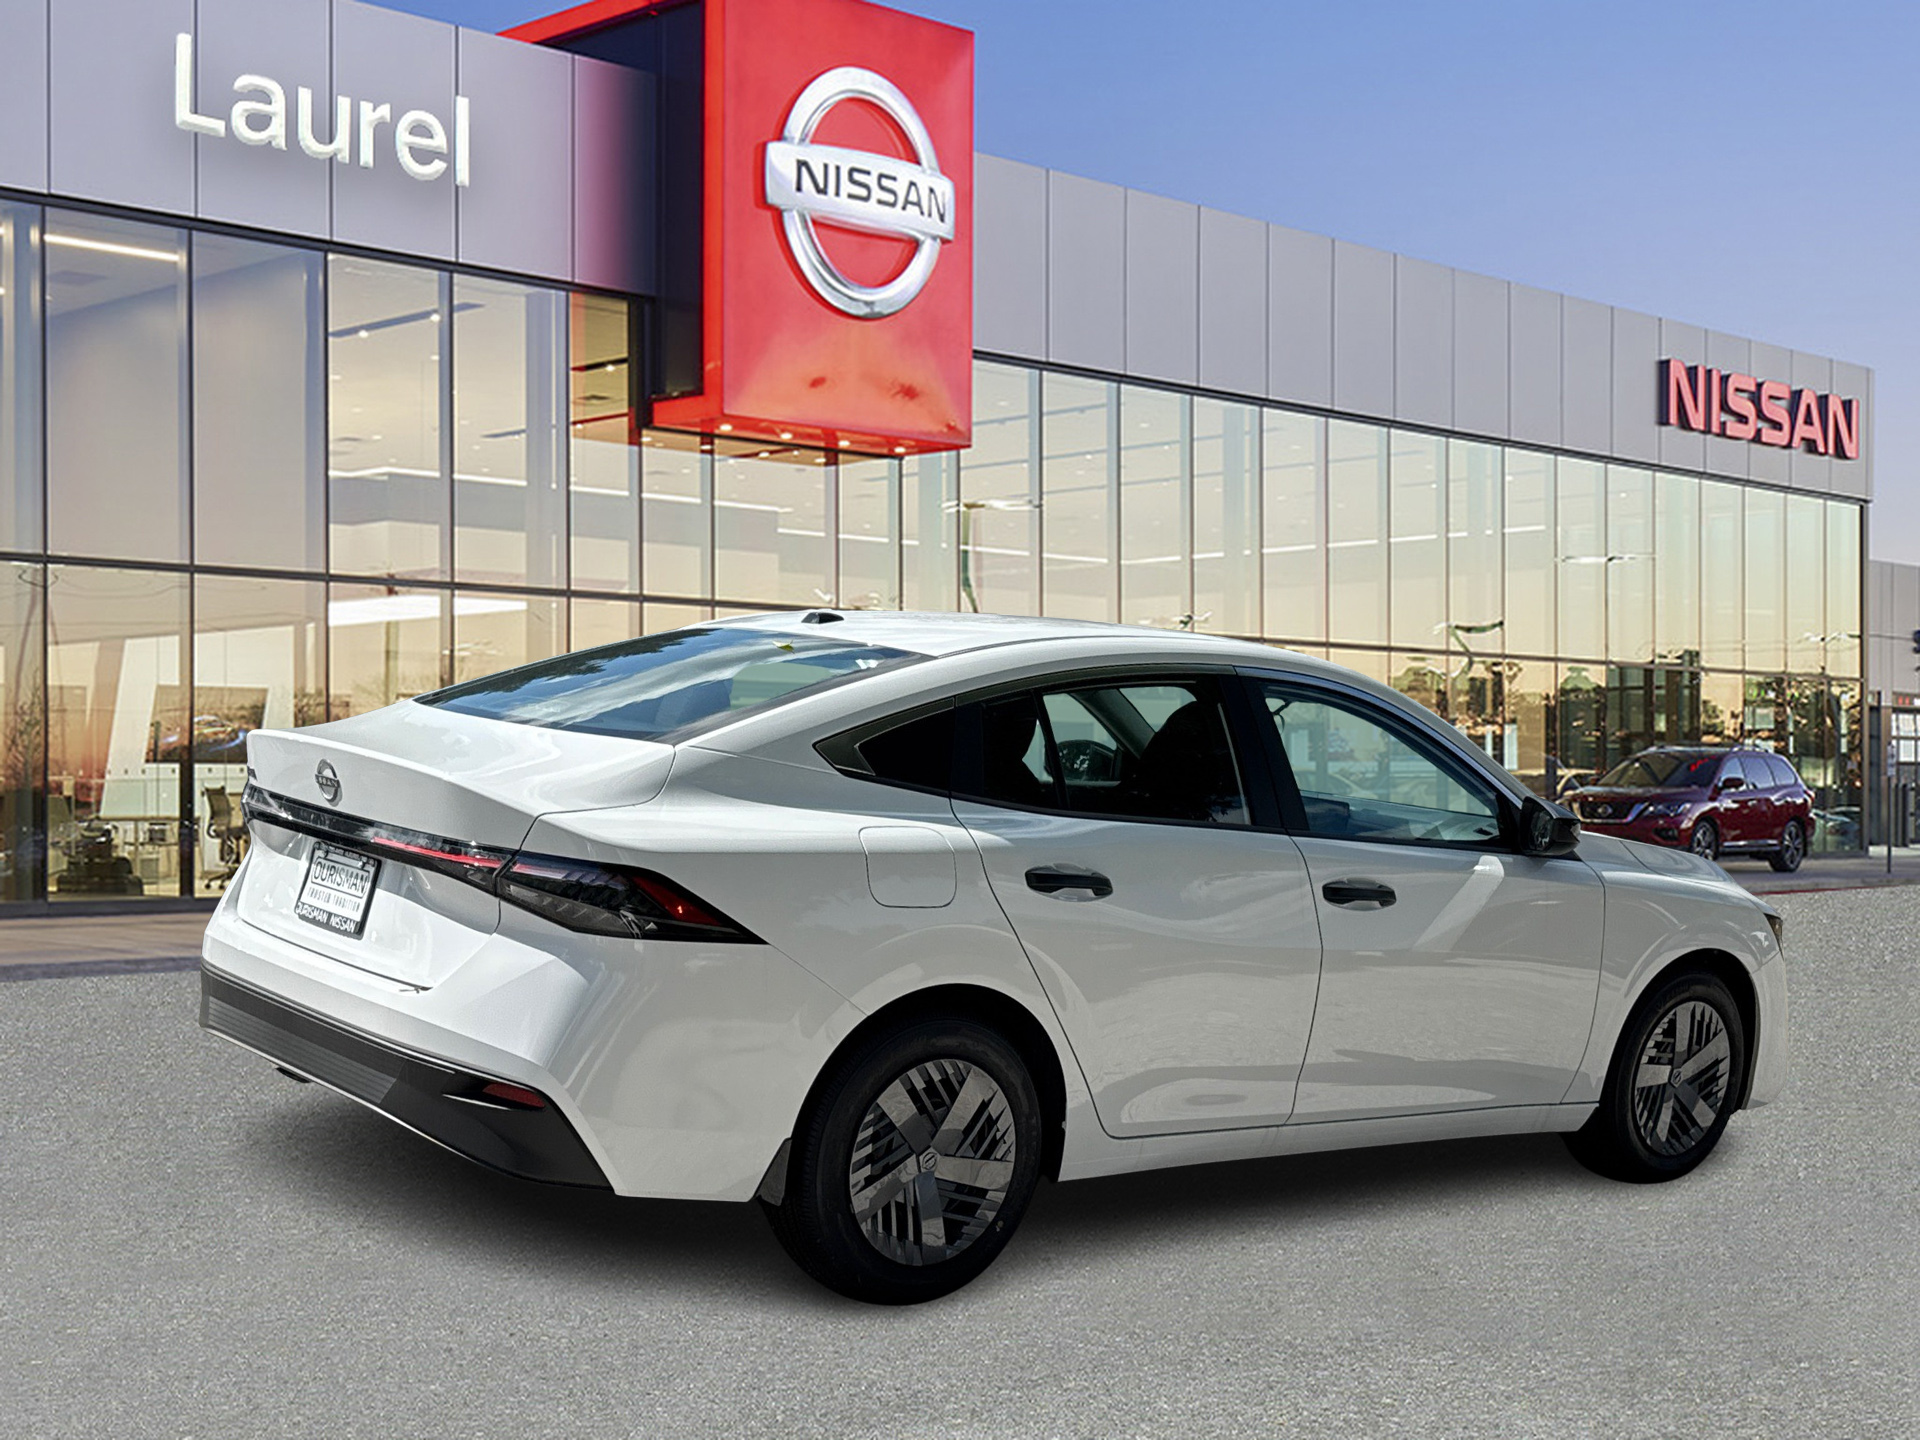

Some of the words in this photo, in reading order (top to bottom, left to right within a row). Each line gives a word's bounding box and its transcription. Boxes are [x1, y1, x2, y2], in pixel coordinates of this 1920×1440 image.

[174, 32, 470, 187] Laurel
[795, 158, 947, 224] NISSAN
[1657, 358, 1859, 459] NISSAN
[314, 861, 368, 894] OURISMAN
[329, 913, 357, 934] NISSAN
